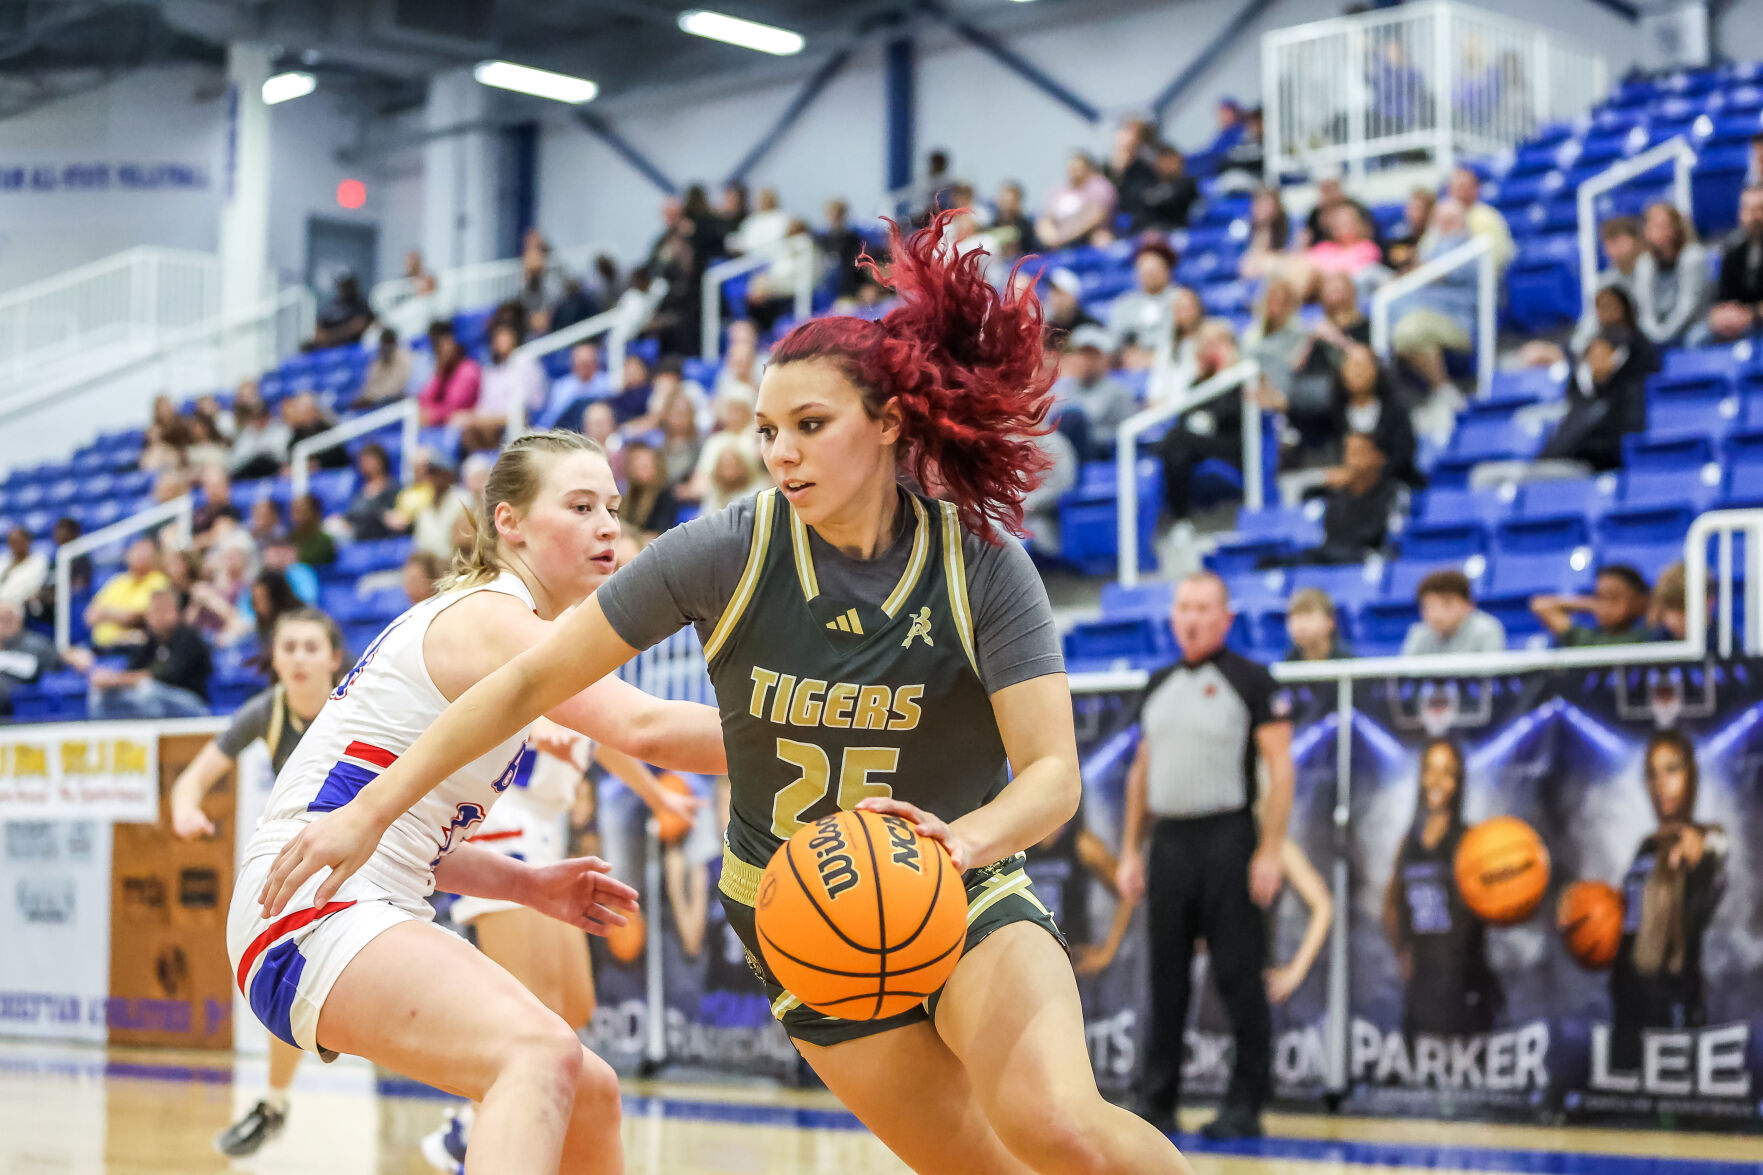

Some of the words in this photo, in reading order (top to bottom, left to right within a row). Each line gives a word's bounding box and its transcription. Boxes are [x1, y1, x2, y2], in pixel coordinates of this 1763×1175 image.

[749, 665, 925, 730] TIGERS
[771, 737, 900, 840] 25
[807, 814, 860, 900] Wilso
[880, 813, 922, 874] NCA
[1351, 1018, 1550, 1089] PARKER
[1590, 1019, 1750, 1096] LEE
